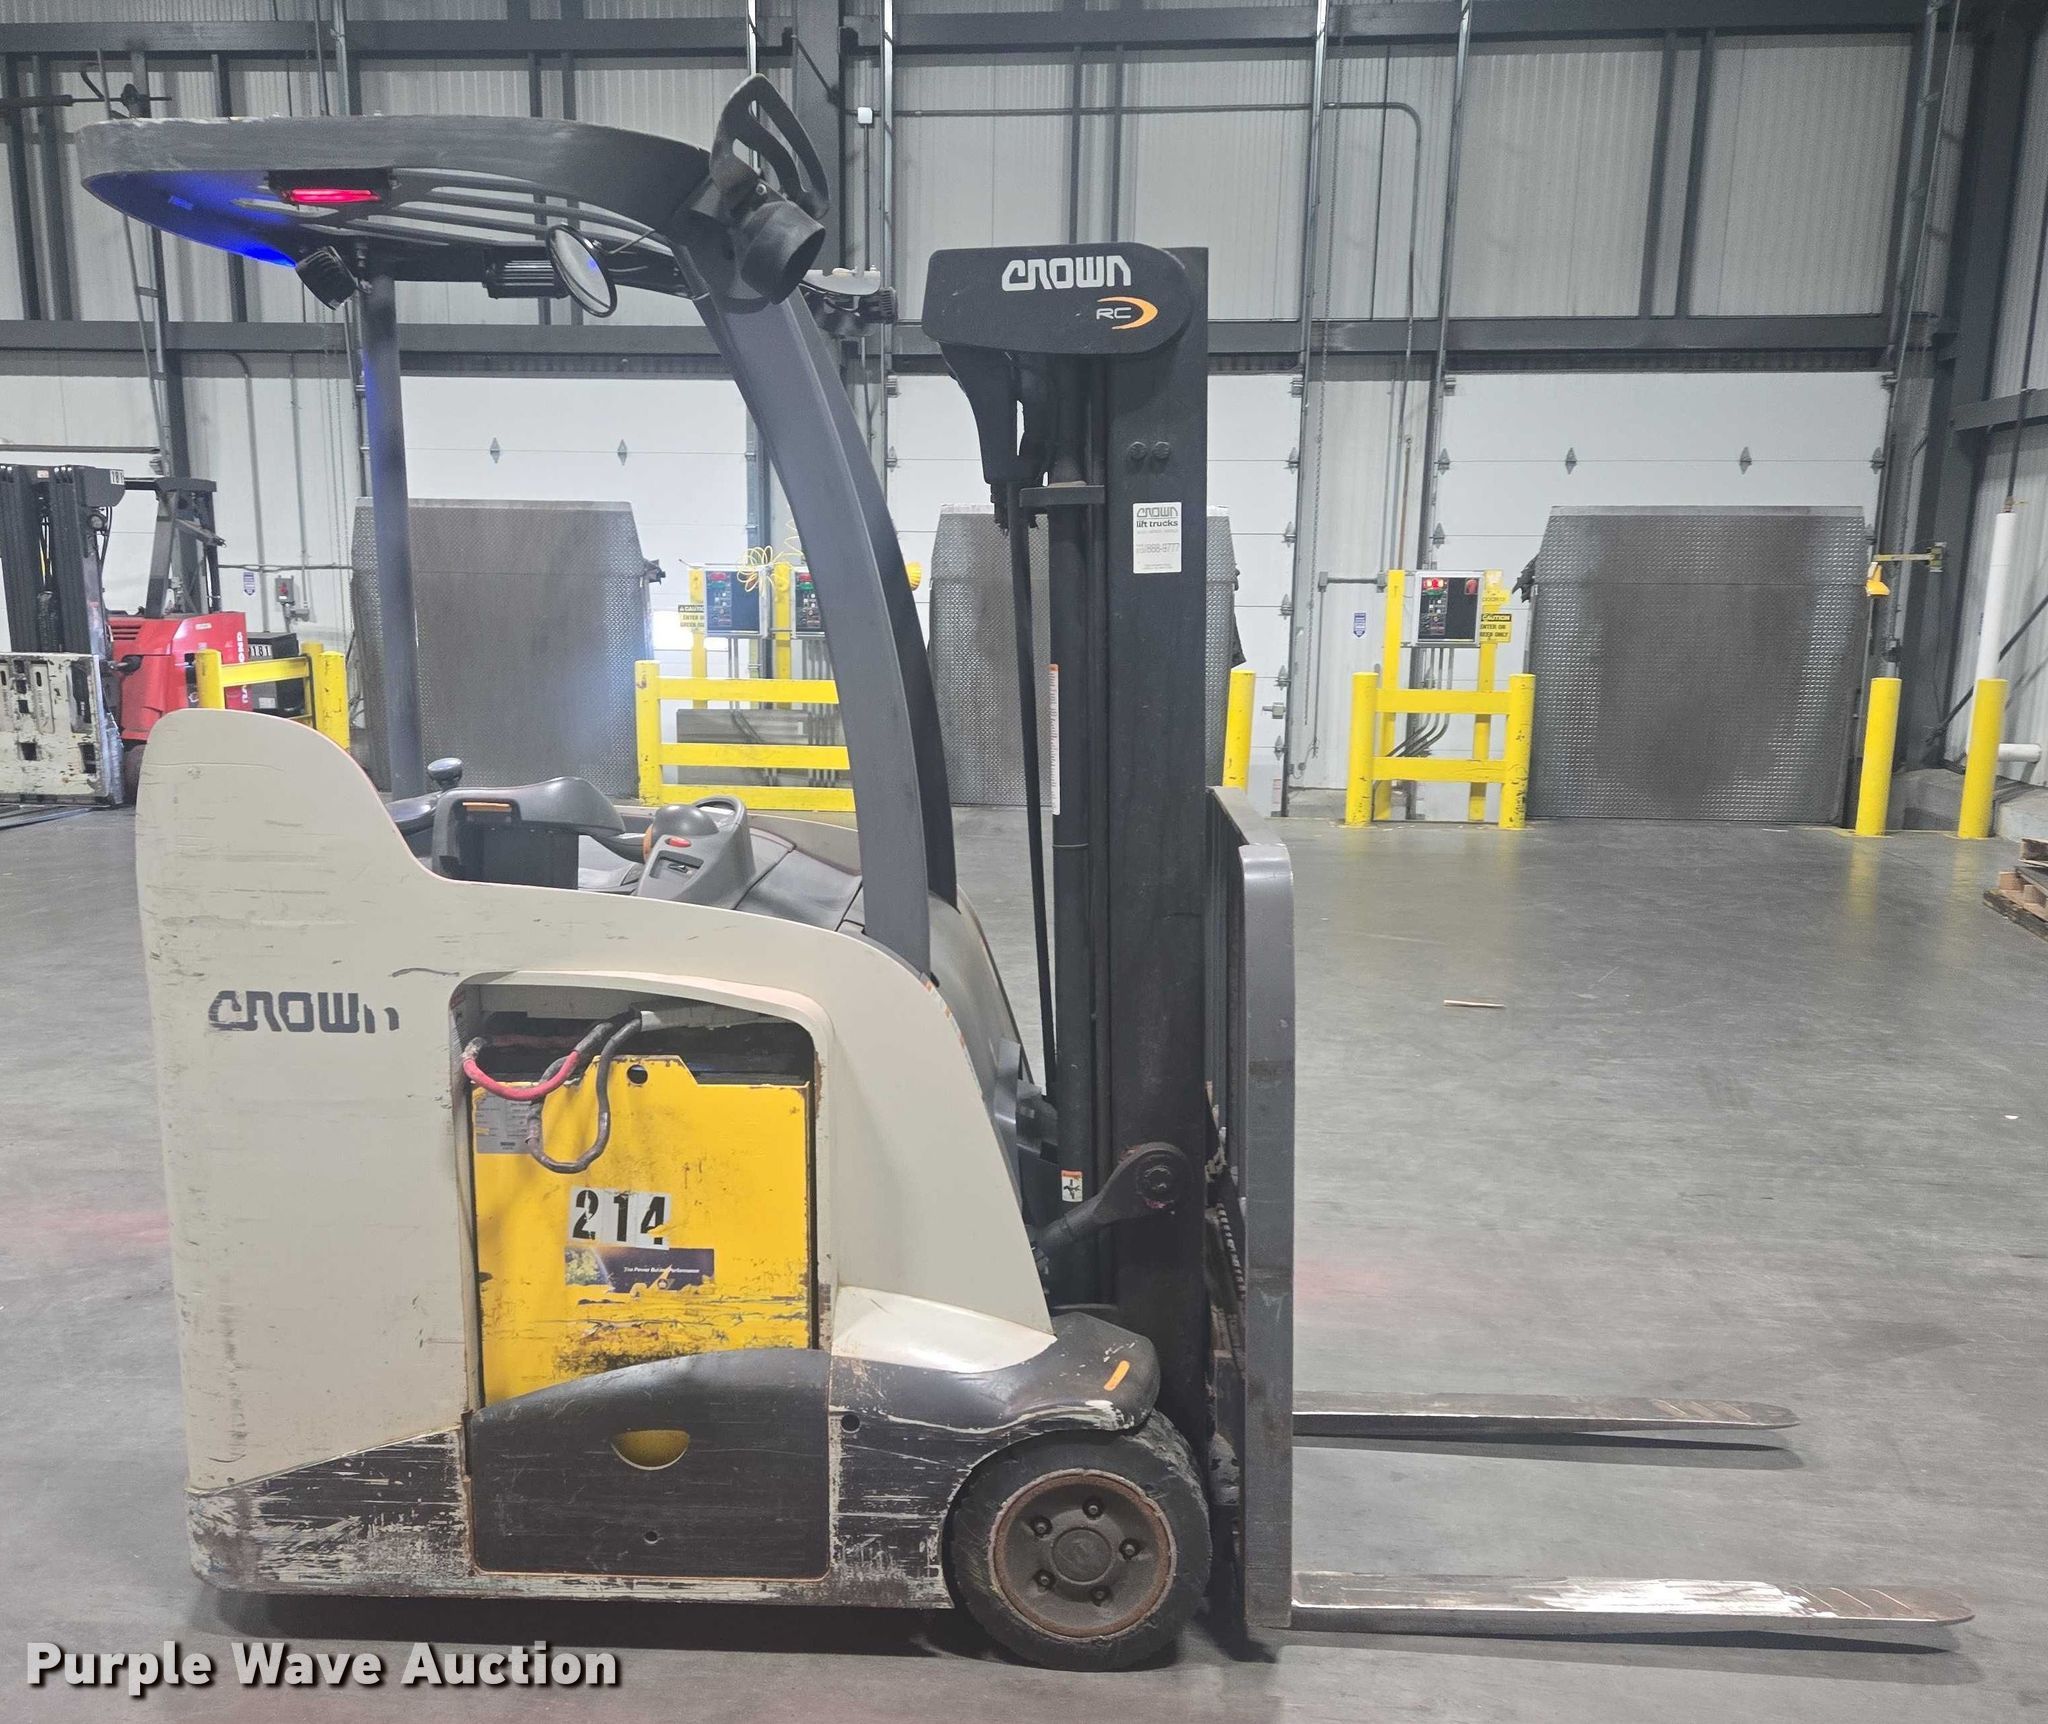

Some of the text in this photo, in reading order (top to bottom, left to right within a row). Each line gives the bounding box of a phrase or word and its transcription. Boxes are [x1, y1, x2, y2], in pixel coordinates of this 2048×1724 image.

[1001, 255, 1132, 292] CROWN
[1096, 306, 1132, 320] RC
[1137, 506, 1179, 518] CROWN
[1149, 519, 1179, 528] trucks
[208, 990, 400, 1033] CROWN
[572, 1189, 666, 1245] 214
